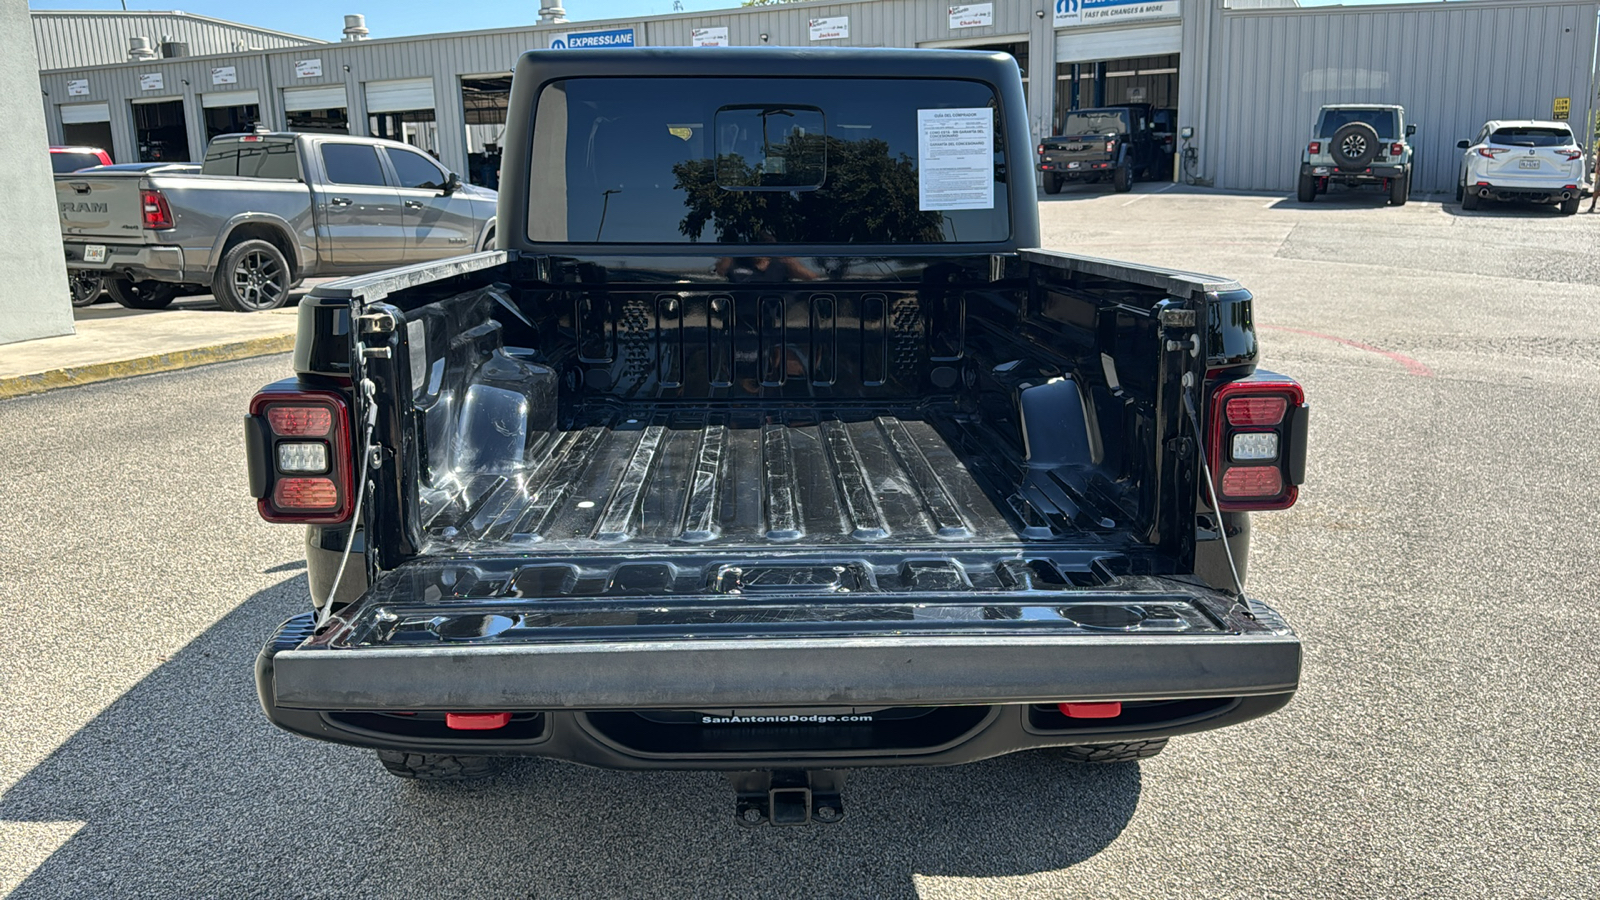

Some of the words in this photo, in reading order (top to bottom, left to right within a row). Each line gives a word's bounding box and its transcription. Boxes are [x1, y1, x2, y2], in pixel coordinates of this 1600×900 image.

[1110, 7, 1138, 16] CHANGES
[1145, 5, 1163, 13] MORE
[569, 33, 632, 47] EXPRESSLANE
[60, 202, 108, 213] RAM
[702, 714, 873, 724] SanAntonioDodge.com
